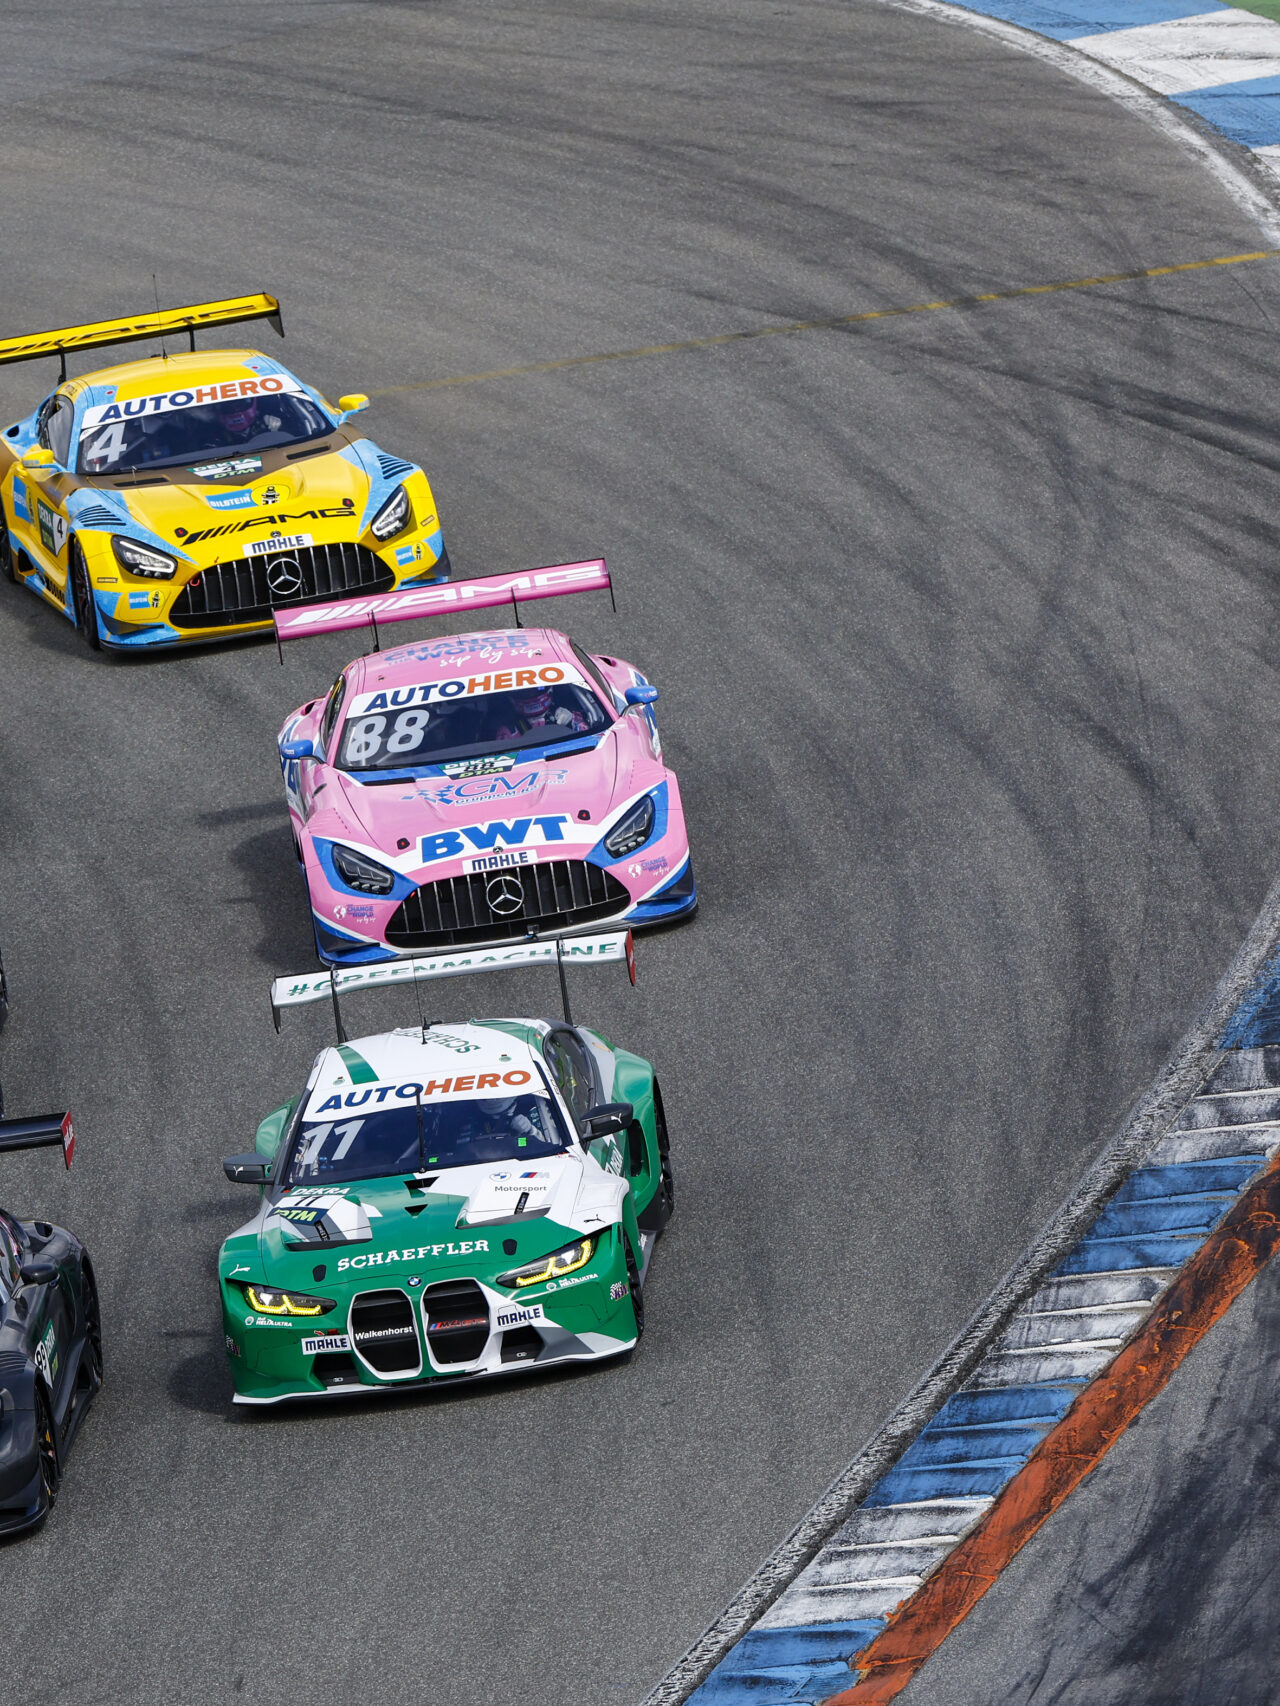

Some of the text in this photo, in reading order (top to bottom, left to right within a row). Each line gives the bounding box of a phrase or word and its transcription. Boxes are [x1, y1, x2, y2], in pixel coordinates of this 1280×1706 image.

[98, 377, 284, 423] AUTOHERO
[86, 421, 128, 463] 4
[192, 457, 257, 472] DEKRA
[213, 467, 256, 479] DTM
[210, 495, 251, 508] BILSTEIN
[56, 518, 64, 539] 4
[235, 506, 357, 533] AMG
[251, 534, 305, 554] MAHLE
[384, 564, 602, 612] AMG
[440, 646, 542, 667] sip by sip
[363, 666, 565, 713] AUTOHERO
[345, 709, 430, 763] 88
[444, 755, 513, 770] DEKRA
[463, 762, 495, 773] 88
[458, 767, 504, 779] DTM
[421, 815, 568, 864] BWT
[471, 852, 529, 872] MAHLE
[288, 941, 618, 997] #GREENMACHNE
[315, 1070, 532, 1114] AUTOHERO
[301, 1120, 366, 1165] 11
[291, 1187, 351, 1196] DEKRA
[494, 1184, 548, 1194] Motorsport
[294, 1195, 324, 1207] 11
[273, 1209, 318, 1222] DTM
[337, 1239, 490, 1273] SCHAEFFLER
[496, 1307, 542, 1326] MAHLE
[354, 1324, 413, 1341] Walkenhorst
[305, 1337, 348, 1352] MAHLE
[36, 1345, 48, 1372] 99
